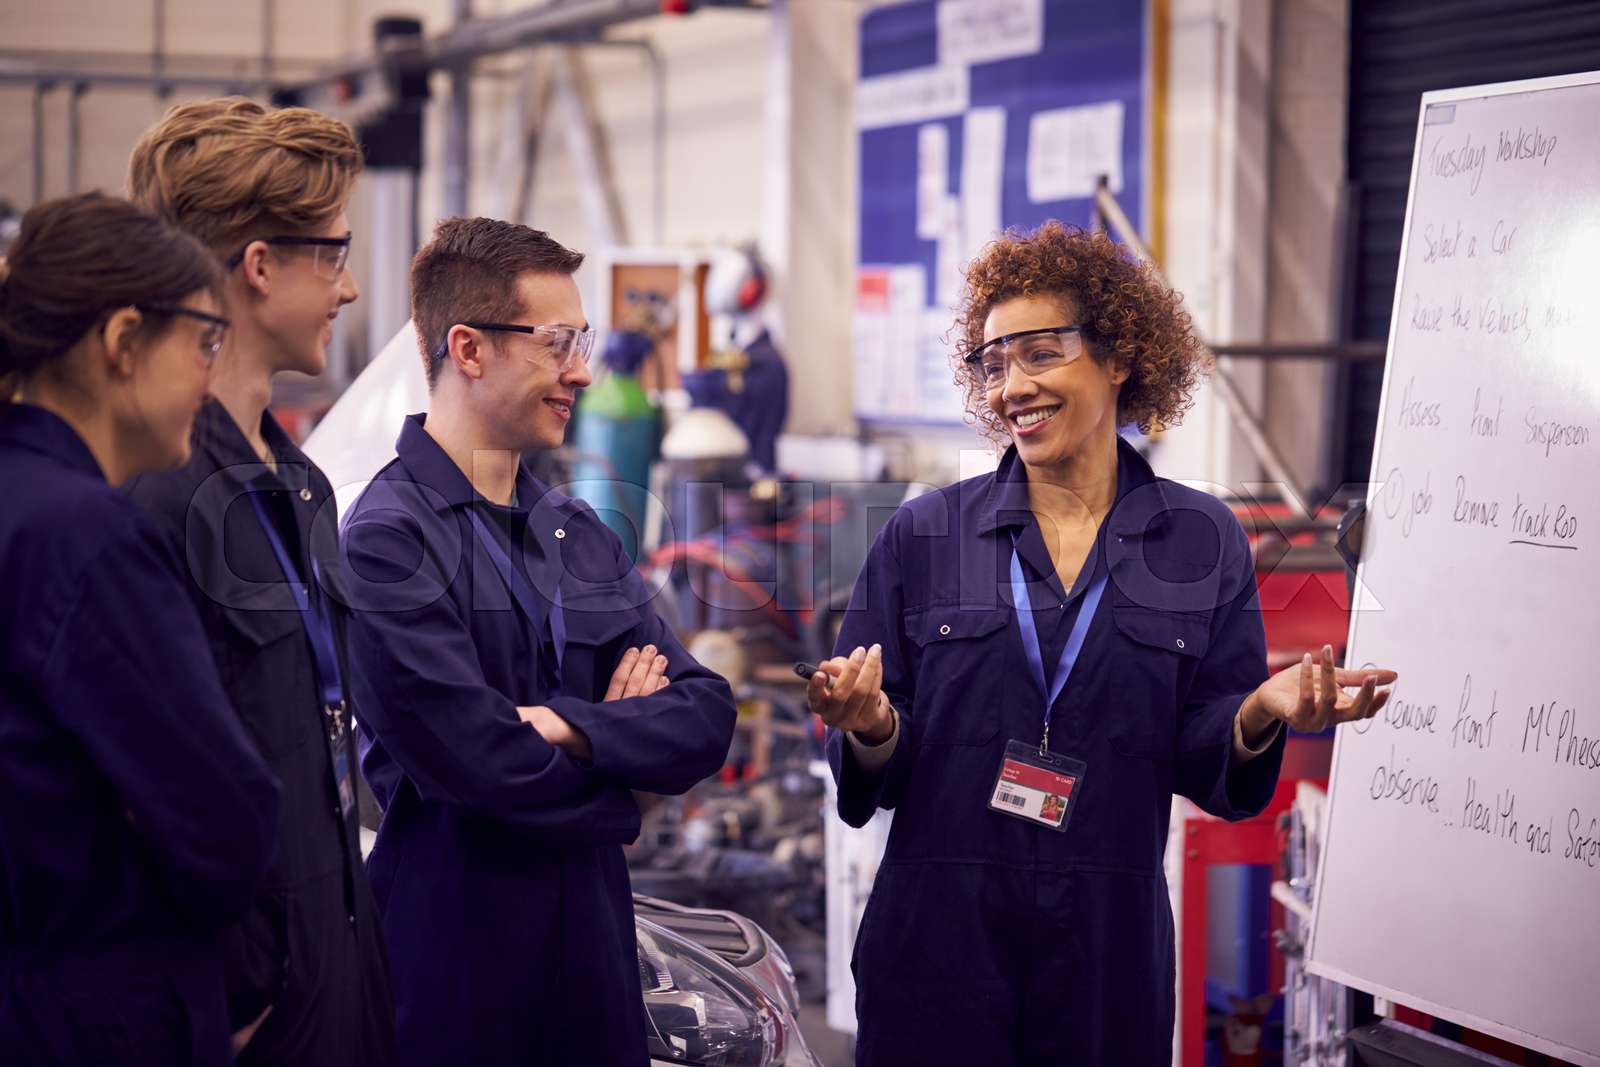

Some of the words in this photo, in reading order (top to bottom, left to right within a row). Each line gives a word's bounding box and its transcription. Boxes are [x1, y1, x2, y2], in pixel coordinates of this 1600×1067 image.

[1429, 133, 1486, 196] Tuesday
[1424, 219, 1463, 263] Select
[1467, 235, 1477, 258] a
[1491, 219, 1518, 256] Car
[1410, 293, 1442, 332] Raise
[1450, 295, 1471, 331] the
[1399, 375, 1441, 430] Assess
[1402, 471, 1433, 538] job
[1453, 475, 1499, 527] Remove
[1461, 776, 1518, 844] Health
[1526, 816, 1553, 854] and
